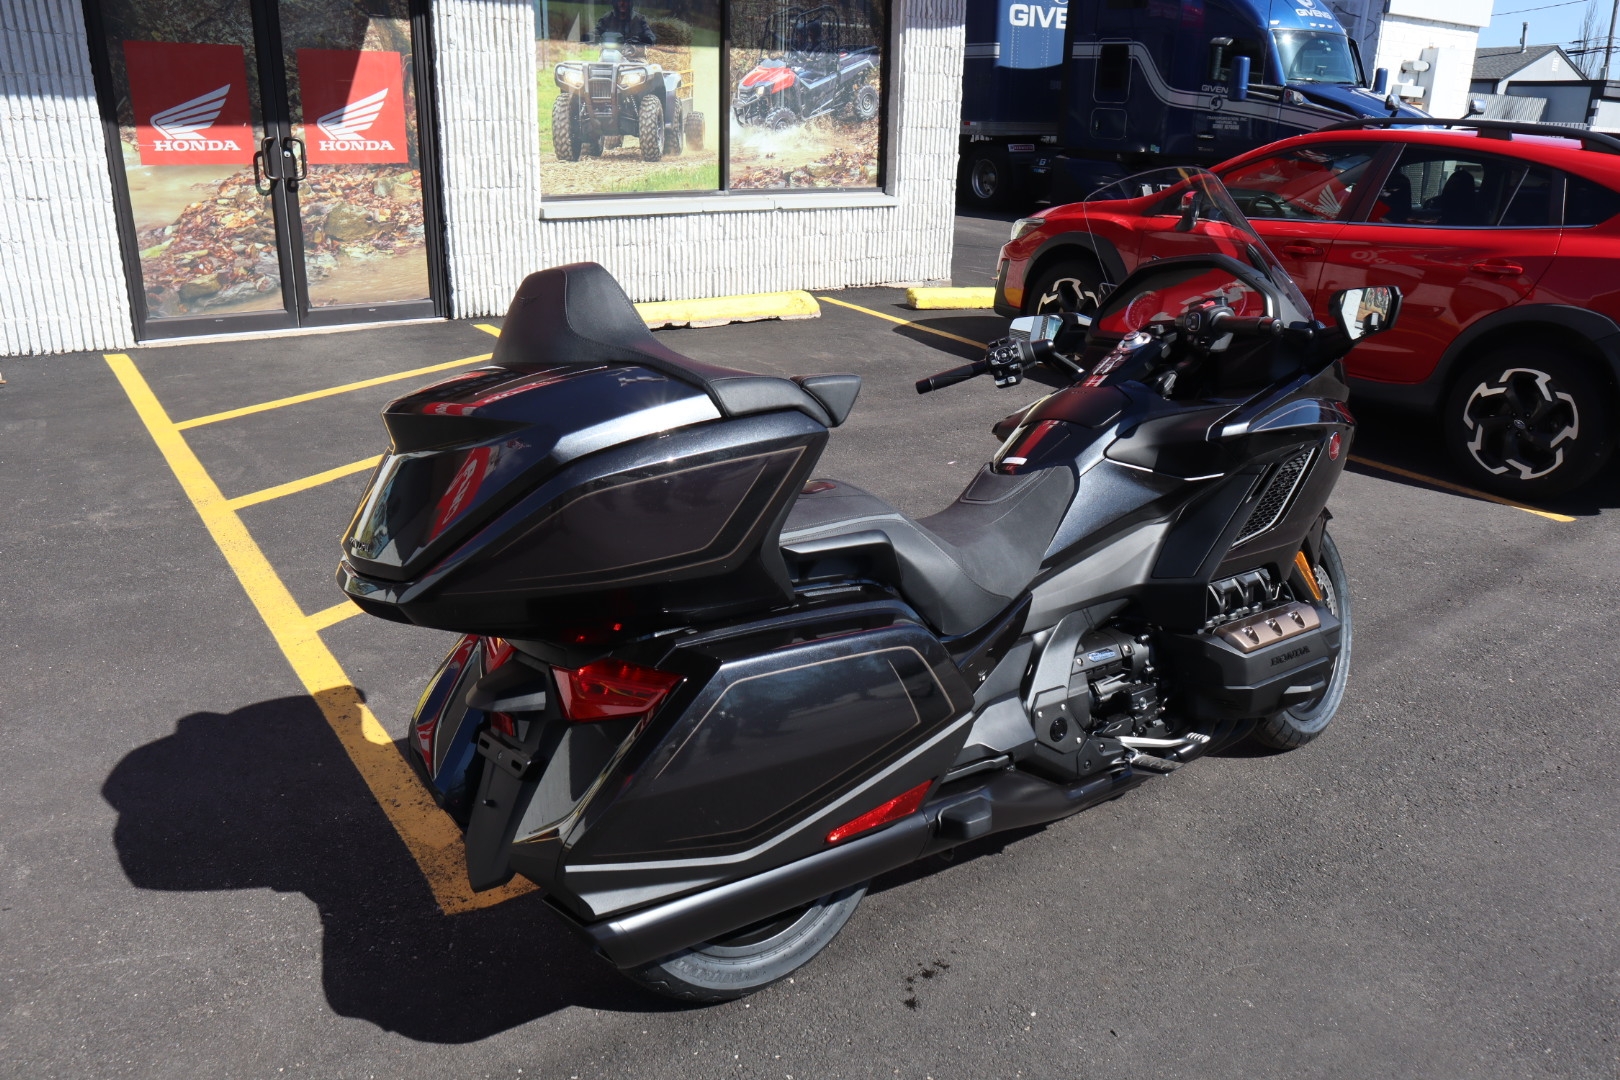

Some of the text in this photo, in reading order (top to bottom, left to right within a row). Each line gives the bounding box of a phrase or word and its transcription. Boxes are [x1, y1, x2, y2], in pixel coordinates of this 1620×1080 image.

[154, 140, 241, 151] HONDA
[319, 140, 396, 151] HONDA
[1270, 645, 1310, 667] HONDA
